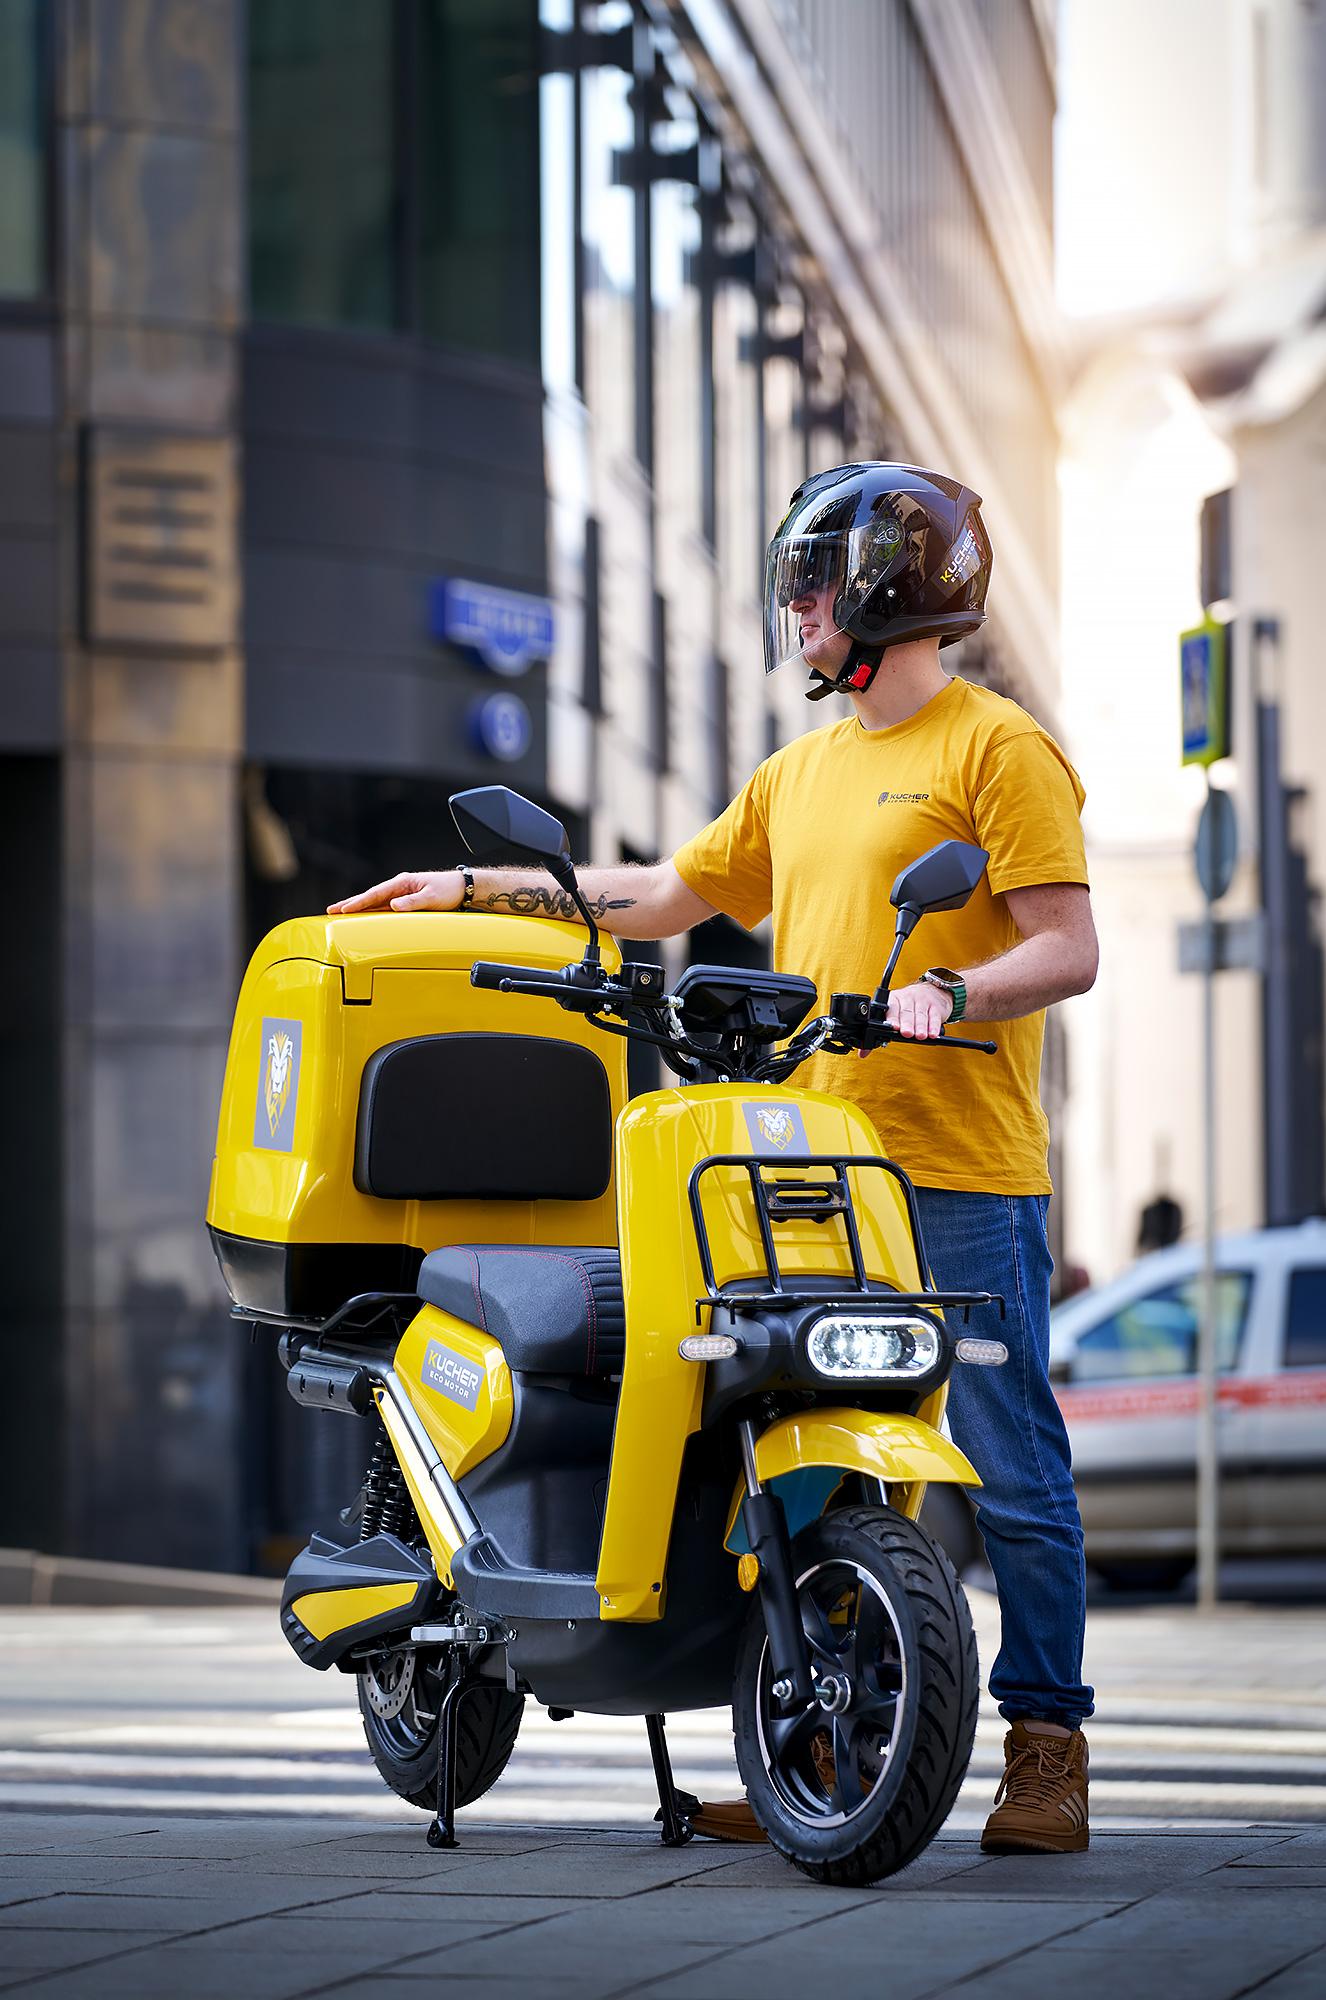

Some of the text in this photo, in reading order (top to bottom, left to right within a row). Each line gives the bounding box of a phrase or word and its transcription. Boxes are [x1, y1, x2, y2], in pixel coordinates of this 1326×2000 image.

[940, 529, 975, 583] KUCHER
[950, 540, 977, 583] ECO MOTOR
[890, 793, 930, 801] KUCHER
[427, 1349, 479, 1391] KUCHER
[429, 1370, 469, 1399] ECO MOTOR
